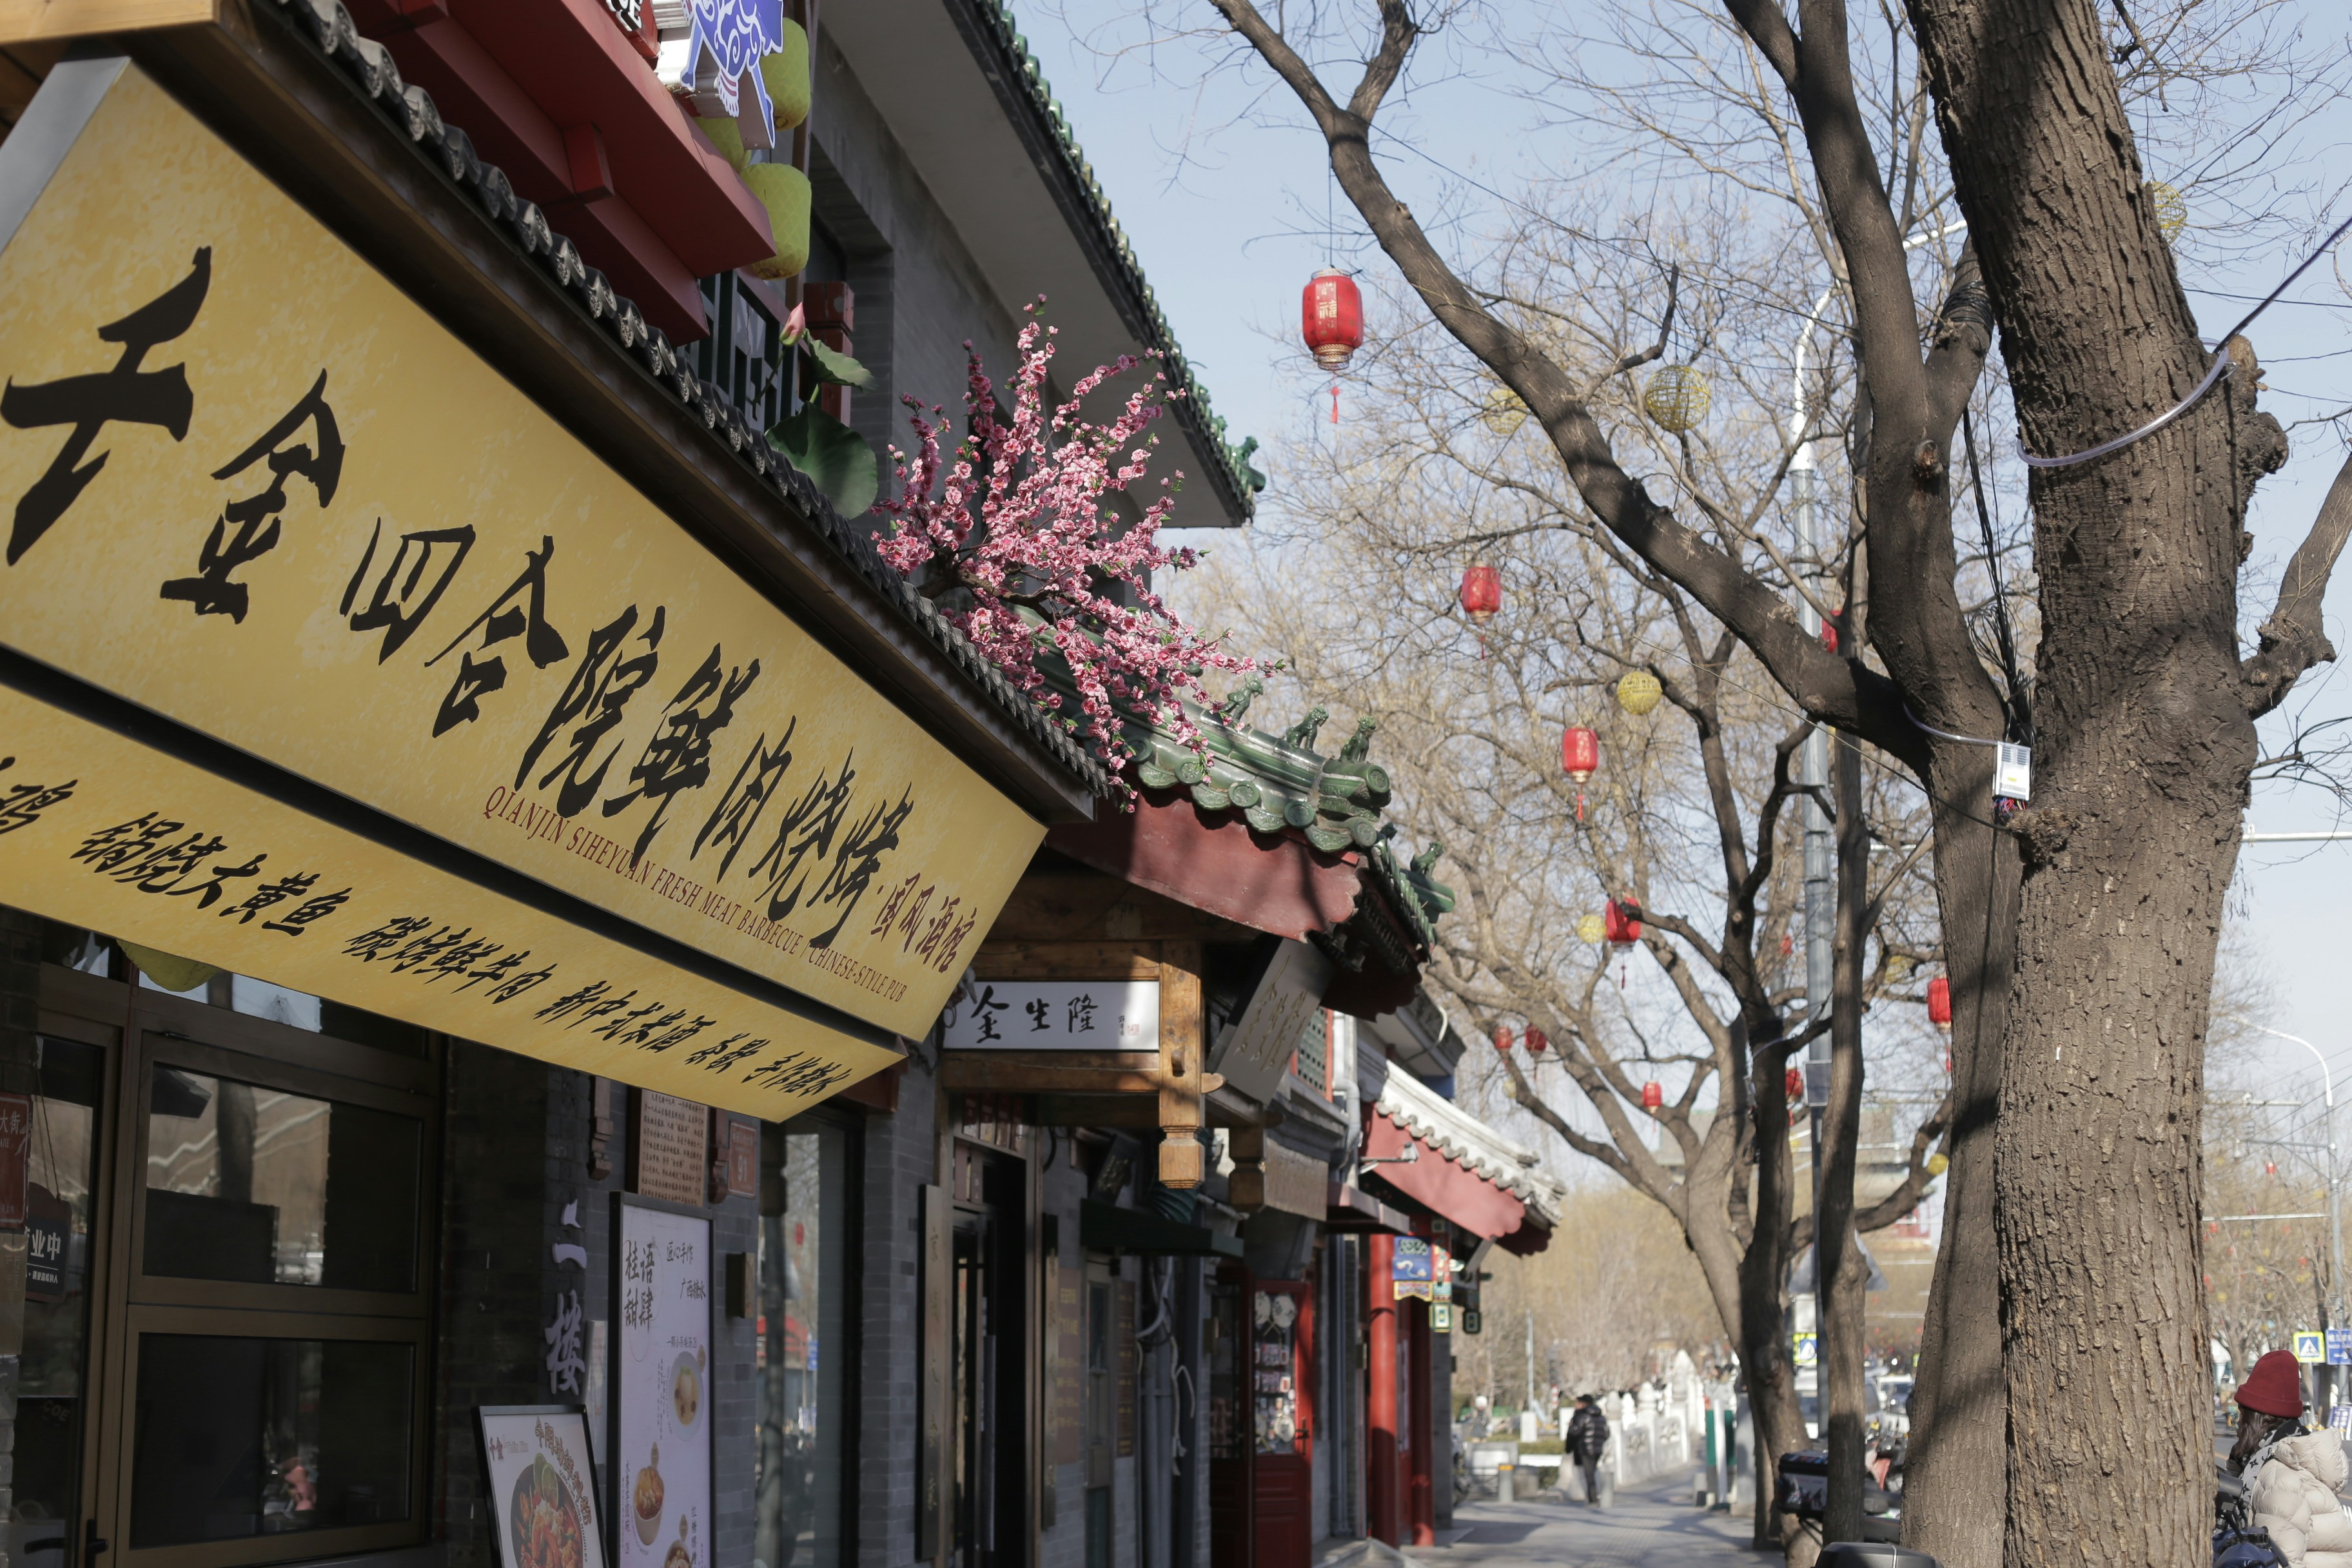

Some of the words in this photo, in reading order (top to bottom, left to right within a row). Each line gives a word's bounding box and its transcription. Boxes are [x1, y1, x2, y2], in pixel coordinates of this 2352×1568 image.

[1319, 300, 1337, 318] 福
[482, 785, 571, 845] QIANJIN
[565, 827, 656, 885] SIHEYUAN
[651, 868, 703, 908] FRESH
[698, 890, 742, 925] MEAT
[736, 909, 803, 956] BARBECUE
[808, 943, 888, 994] CHINESE-STYLE
[888, 979, 907, 1003] PUB
[0, 756, 78, 834] 鸡
[70, 812, 353, 937] 锅烧大黄鱼
[533, 980, 717, 1054] 新中式茶酒
[684, 1033, 770, 1074] 茶歇
[741, 1051, 850, 1098] 手作糖水
[971, 985, 1098, 1043] 金生隆
[24, 1226, 61, 1260] 业中
[625, 1240, 655, 1284] 桂语
[667, 1240, 694, 1265] 匠心手作
[544, 1198, 587, 1395] 二楼
[623, 1286, 654, 1333] 甜肆
[680, 1277, 706, 1300] 广西糖水
[489, 1437, 504, 1461] 千金
